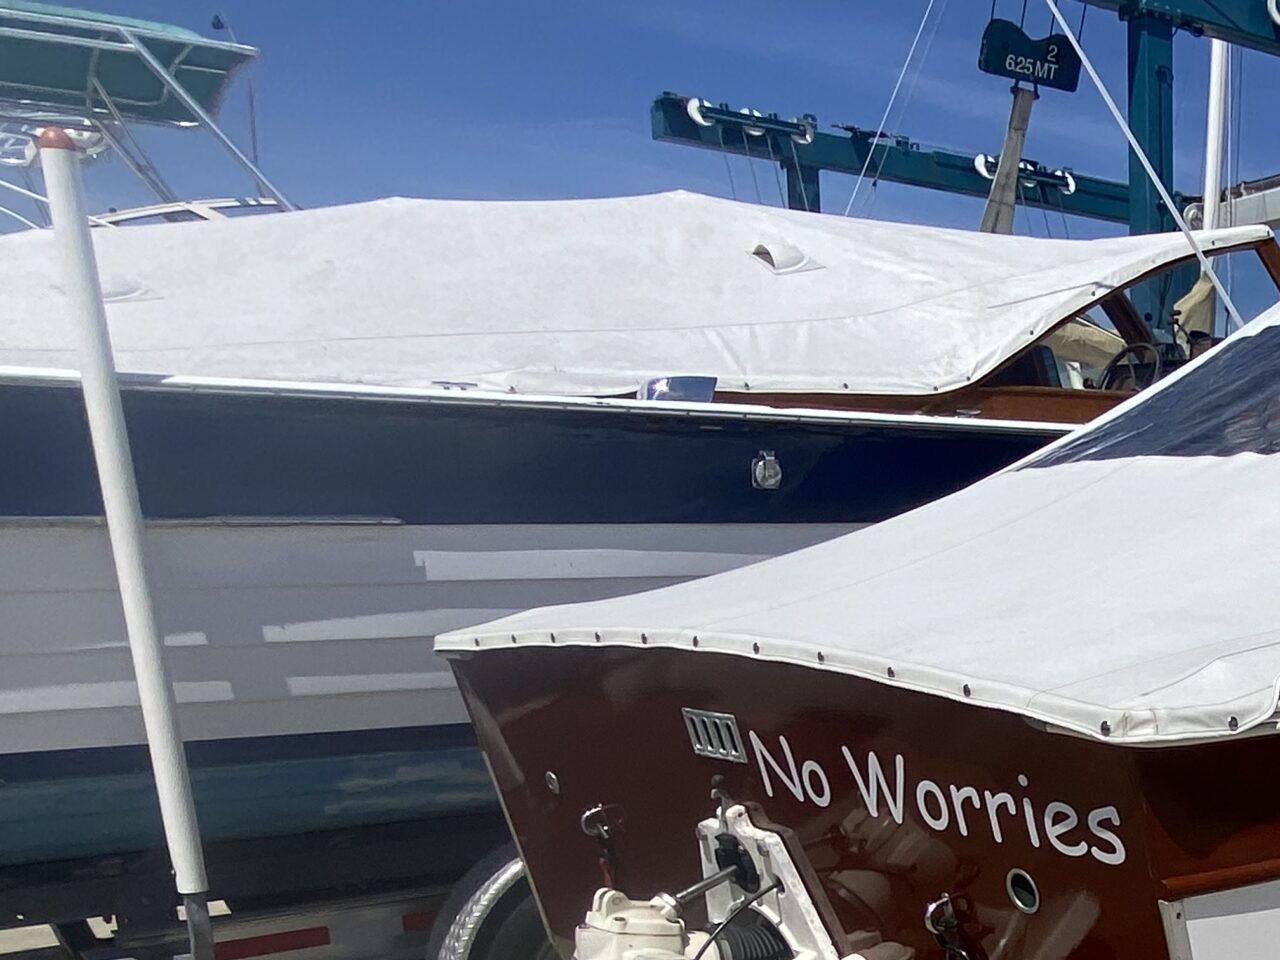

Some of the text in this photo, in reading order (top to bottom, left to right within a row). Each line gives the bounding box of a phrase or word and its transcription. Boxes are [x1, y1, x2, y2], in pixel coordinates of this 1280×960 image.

[1047, 45, 1058, 62] 2
[1034, 60, 1059, 80] MT
[748, 729, 1127, 866] No Worries
